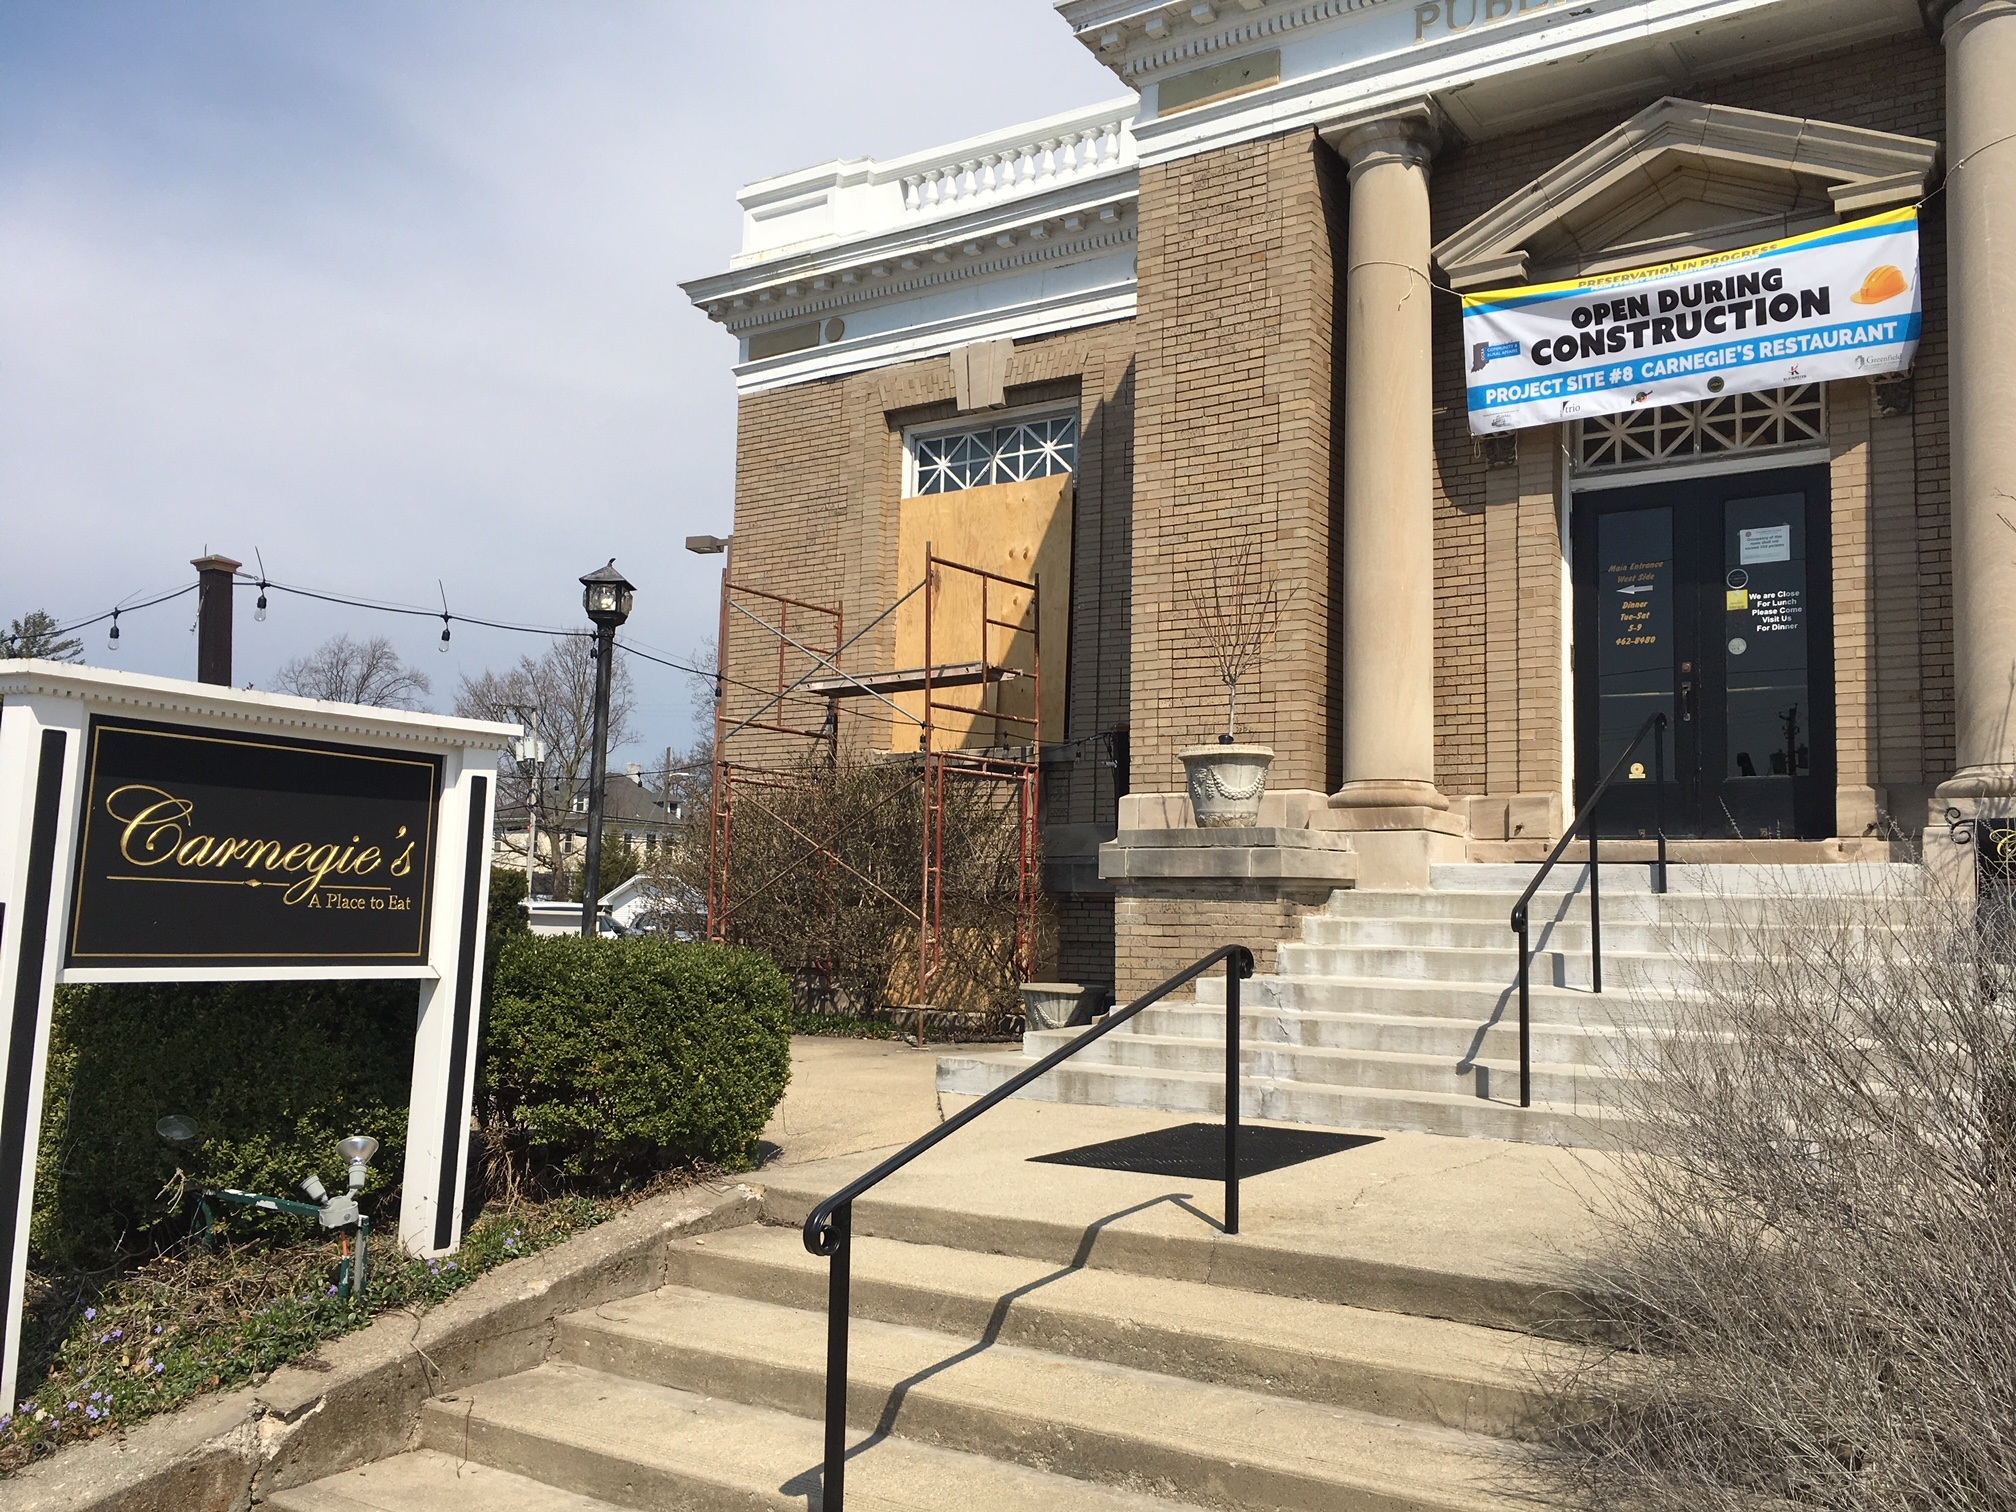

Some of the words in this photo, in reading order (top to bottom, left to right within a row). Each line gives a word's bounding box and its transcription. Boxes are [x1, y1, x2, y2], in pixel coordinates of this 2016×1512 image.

[1578, 265, 1678, 288] PRESERVATION
[1682, 261, 1697, 270] IN
[1700, 244, 1778, 267] PROGRESS
[1571, 294, 1650, 329] OPEN
[1658, 268, 1783, 313] DURING
[1531, 287, 1831, 367] CONSTRUCTION
[1486, 375, 1562, 405] PROJECT
[1566, 368, 1607, 394] SITE
[1608, 368, 1634, 385] #8
[1640, 345, 1756, 379] CARNEGIE'S
[1760, 322, 1899, 358] RESTAURANT
[1565, 404, 1581, 414] trio
[1608, 564, 1627, 572] Main
[1630, 561, 1664, 570] Entrance
[1617, 574, 1636, 583] West
[1638, 572, 1655, 581] Side
[1777, 590, 1800, 598] Close
[1622, 601, 1648, 609] Dinner
[1757, 600, 1771, 608] For
[1772, 598, 1797, 606] Lunch
[1620, 611, 1650, 621] Tue-Sat
[1628, 623, 1642, 632] 5-9
[1756, 624, 1770, 632] For
[1771, 623, 1798, 631] Dinner
[1616, 636, 1656, 645] 462-8480
[106, 784, 416, 905] Carnegie's
[307, 894, 322, 909] A
[325, 893, 366, 910] Place
[370, 895, 384, 910] to
[388, 895, 411, 911] Eat
